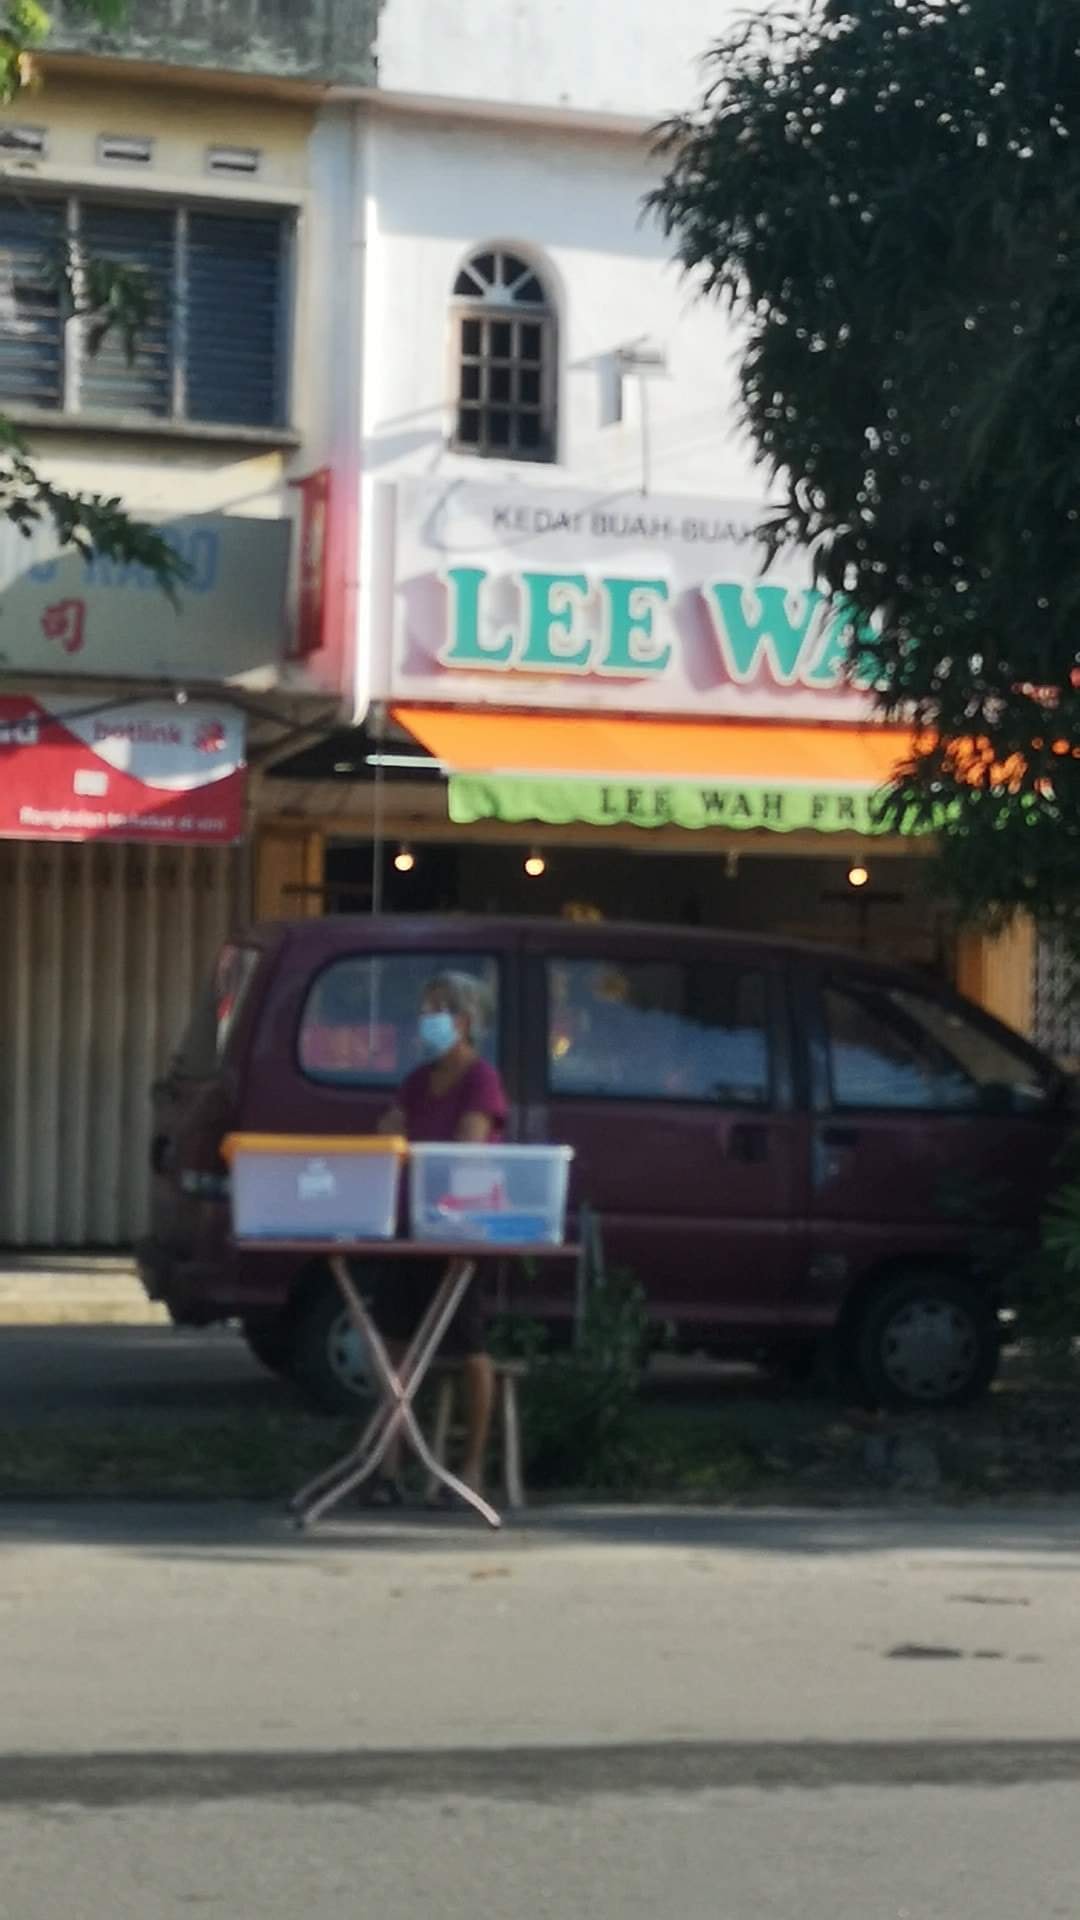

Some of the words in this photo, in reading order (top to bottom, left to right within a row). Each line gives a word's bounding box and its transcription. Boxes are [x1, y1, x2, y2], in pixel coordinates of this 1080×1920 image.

[493, 505, 581, 533] KEDAI
[443, 565, 672, 673] LEE
[601, 786, 672, 817] LEE
[701, 789, 784, 820] WAH
